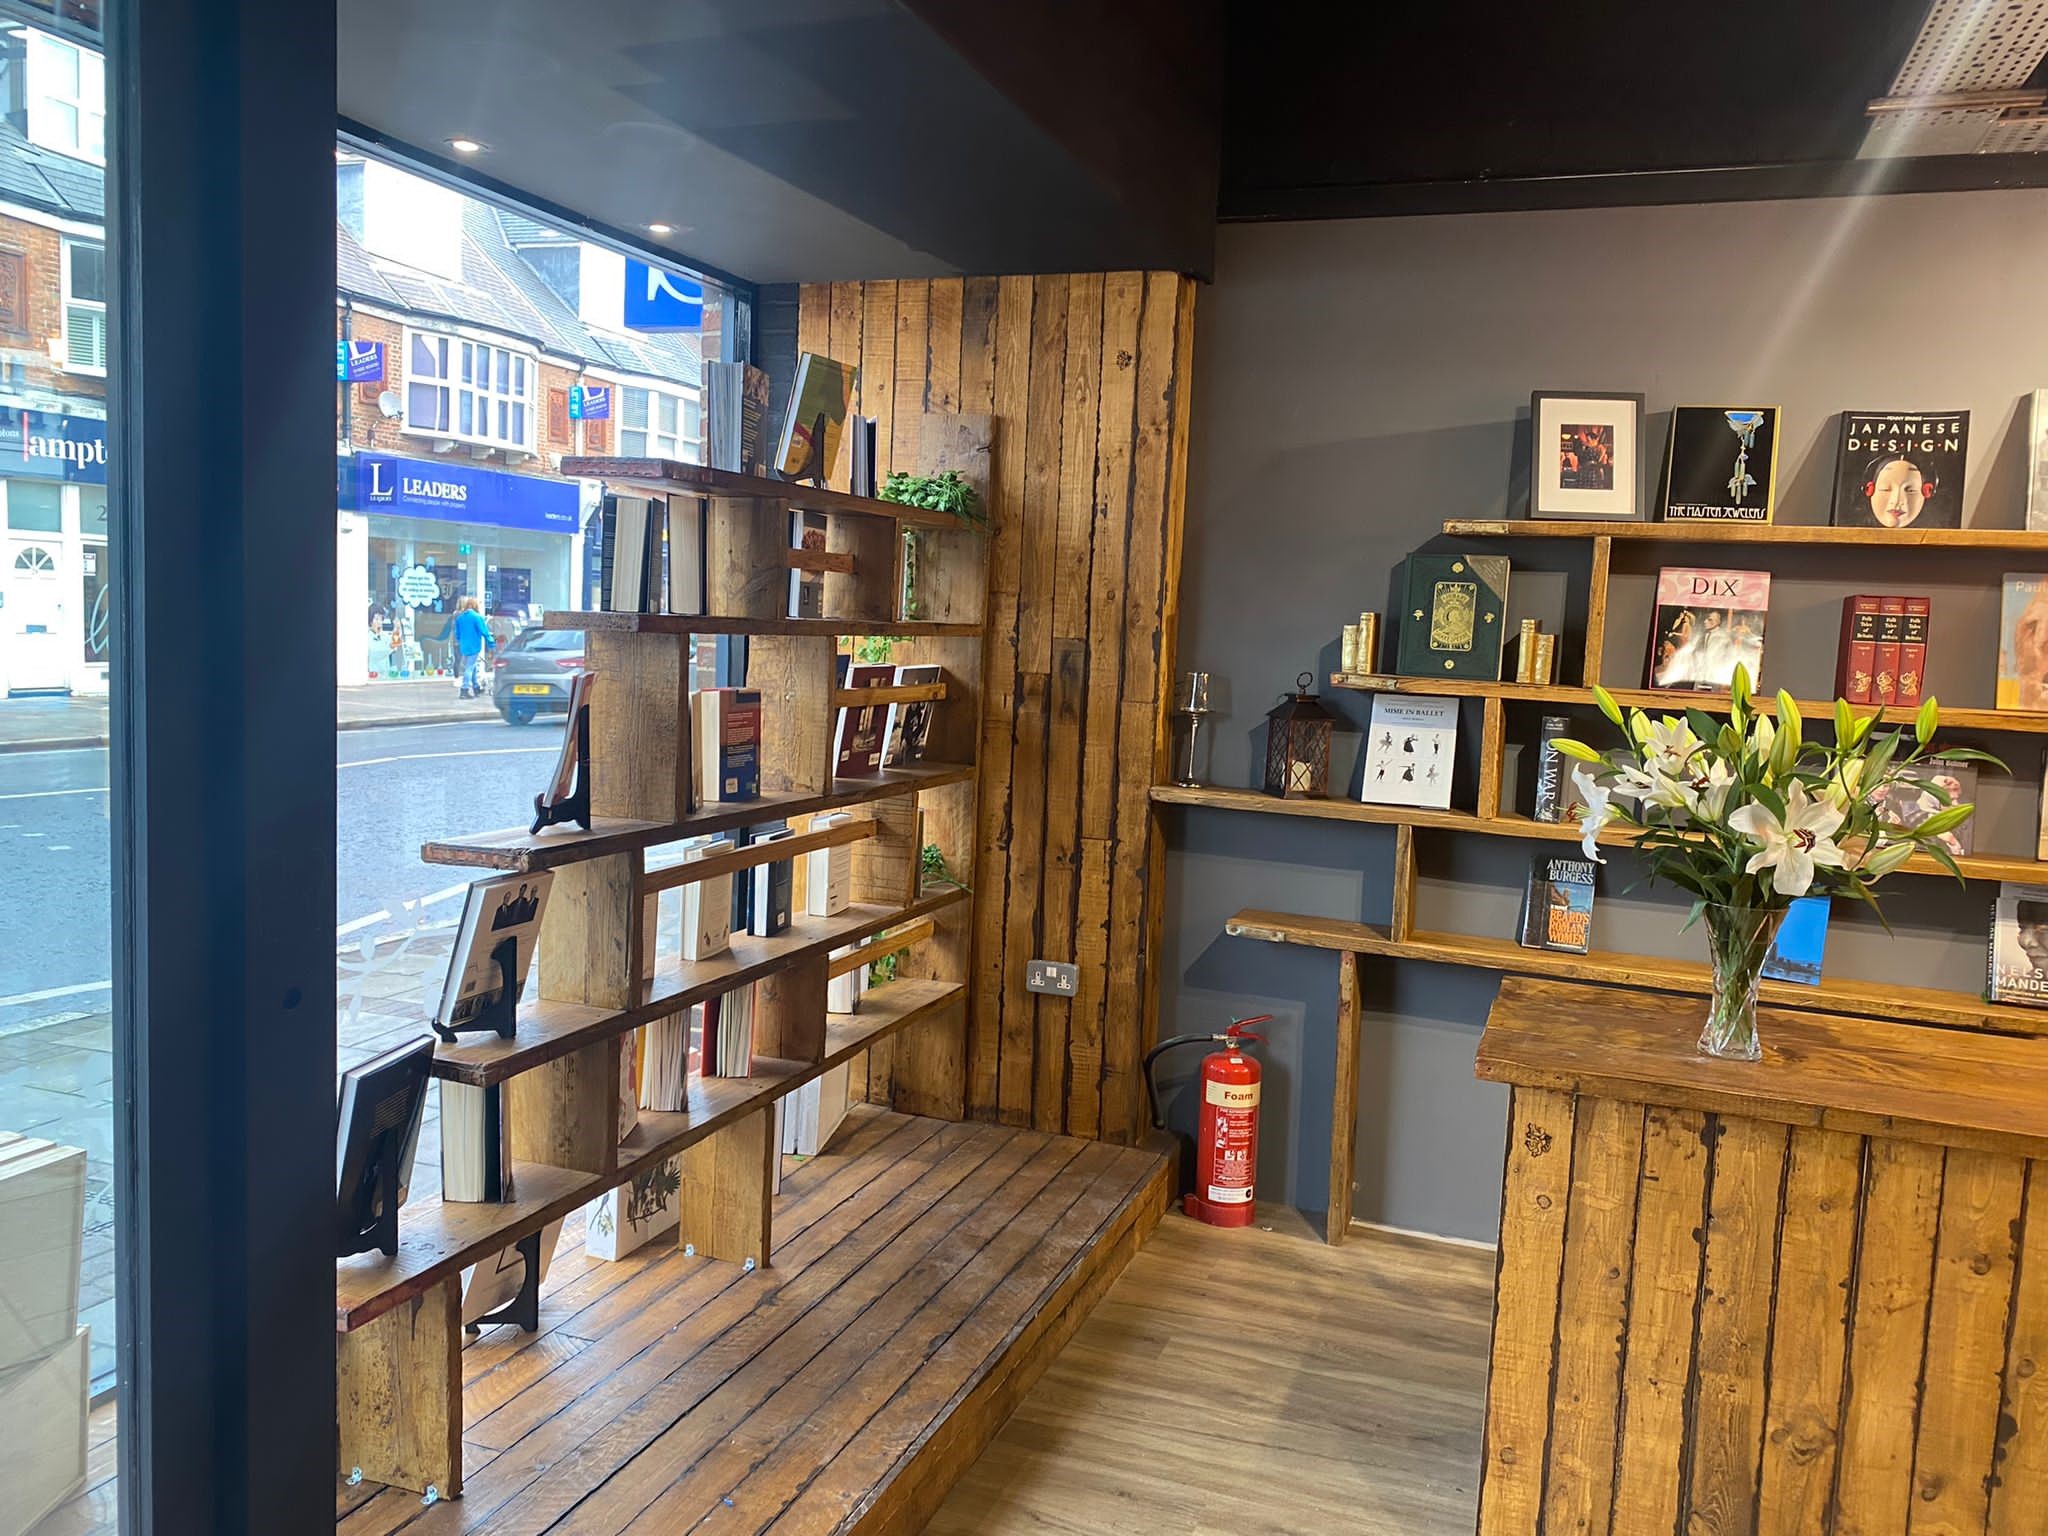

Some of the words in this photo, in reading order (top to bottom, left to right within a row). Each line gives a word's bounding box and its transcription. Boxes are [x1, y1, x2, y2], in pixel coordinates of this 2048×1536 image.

[1850, 422, 1960, 435] JAPANESE
[403, 478, 467, 500] LEADERS
[1669, 506, 1685, 517] THE
[1686, 506, 1721, 517] MASTER
[1723, 507, 1766, 519] JEWELERS
[1691, 577, 1738, 597] DIX
[1543, 768, 1557, 801] WAR
[1547, 859, 1595, 874] ANTHONY
[1549, 870, 1594, 885] BURGESS
[1550, 910, 1590, 924] BEARD'S
[1550, 919, 1585, 935] ROMAN
[1550, 931, 1586, 945] WOMEN
[1997, 963, 2048, 979] NELS
[1224, 1091, 1254, 1101] Foam
